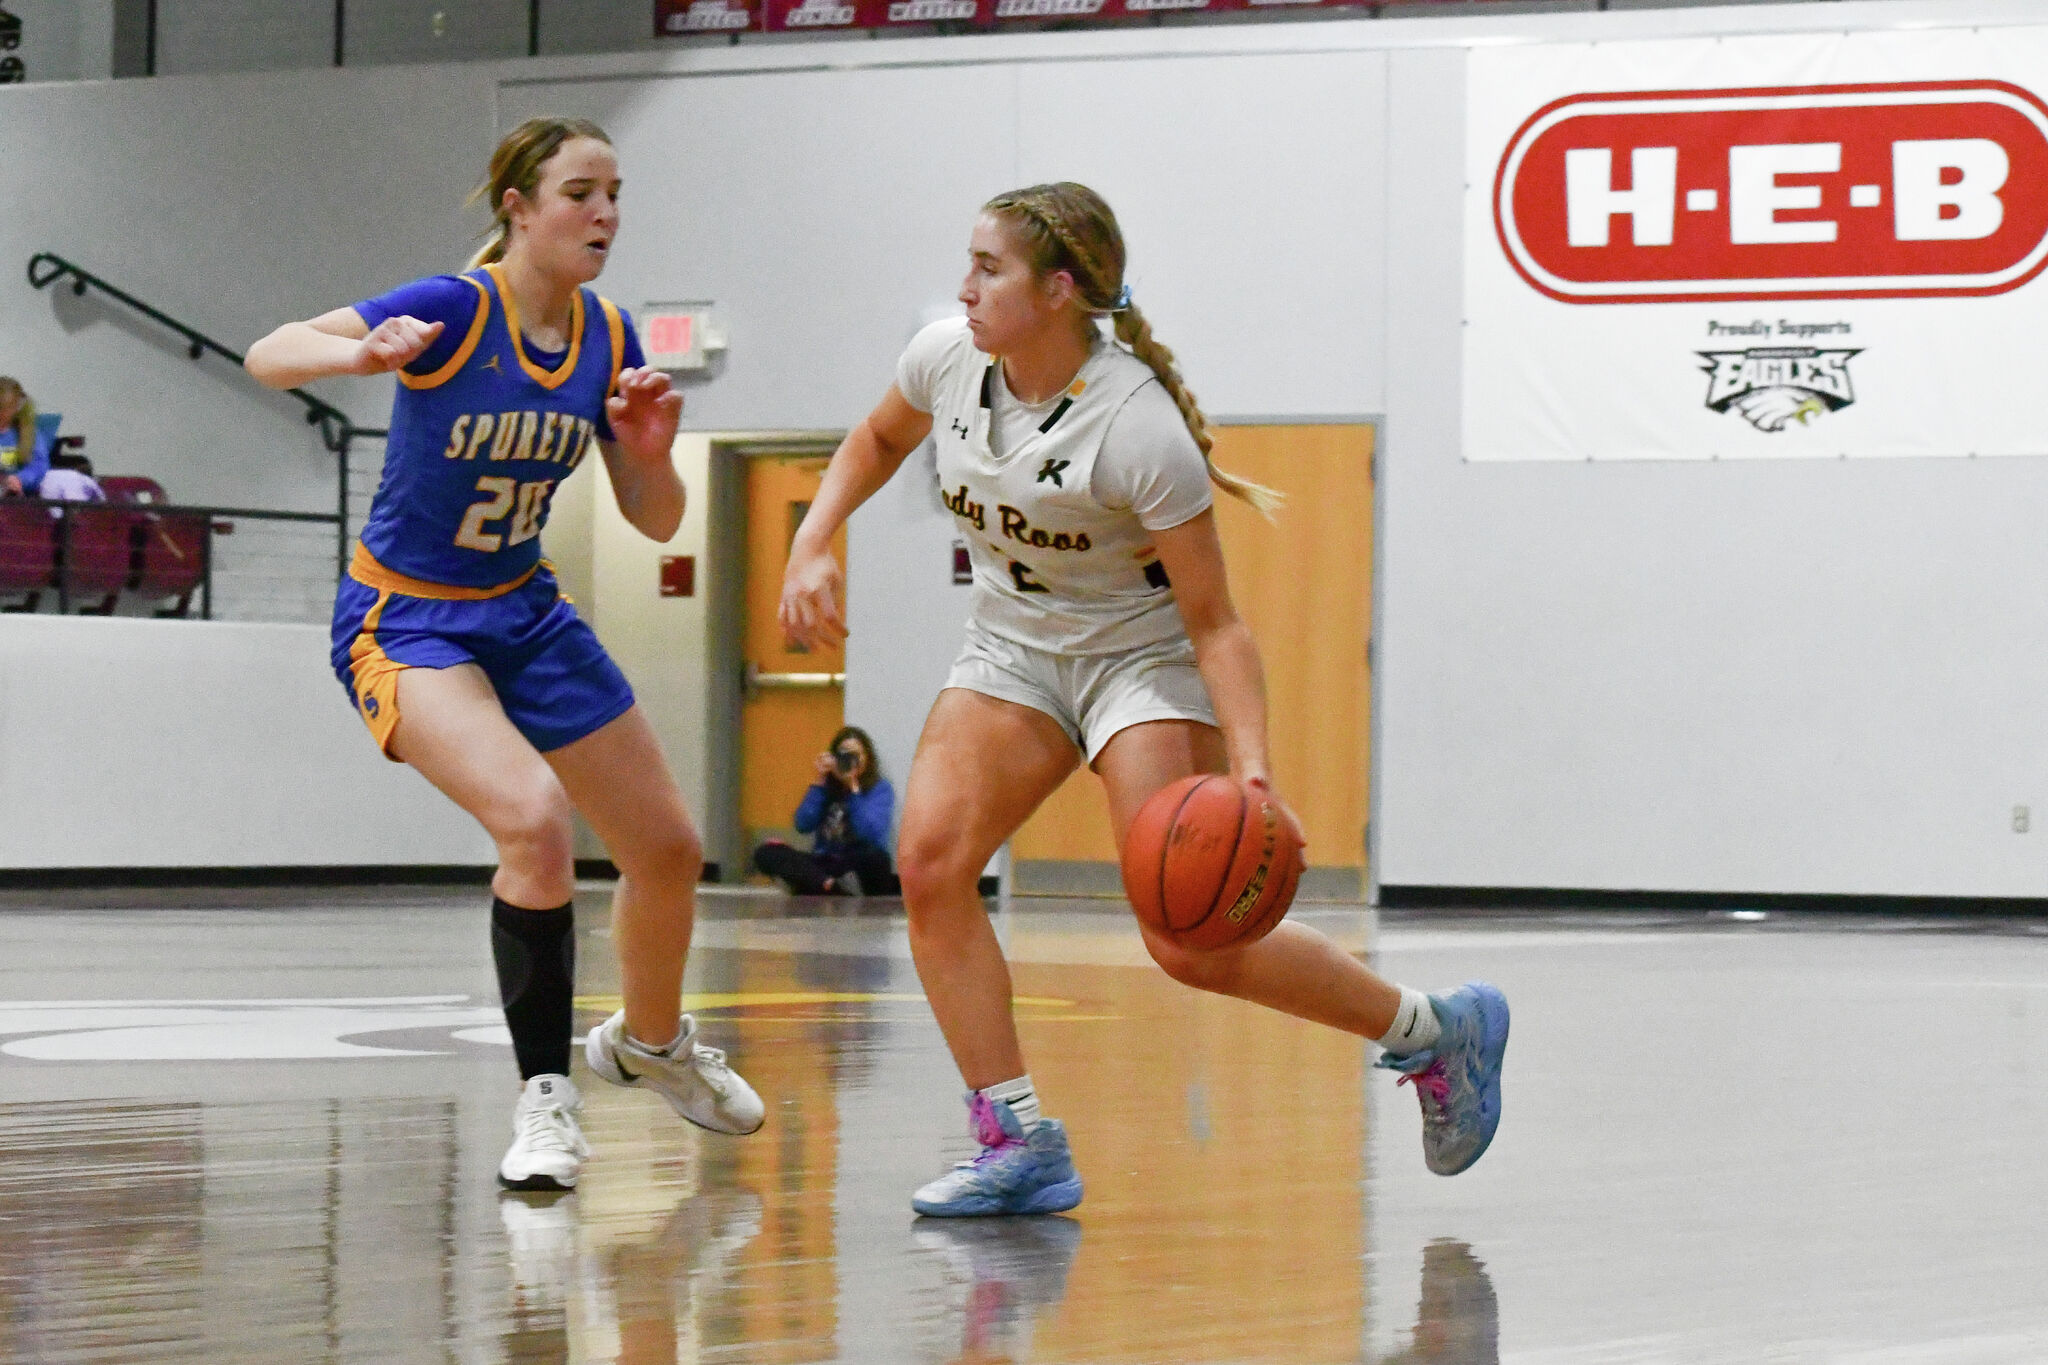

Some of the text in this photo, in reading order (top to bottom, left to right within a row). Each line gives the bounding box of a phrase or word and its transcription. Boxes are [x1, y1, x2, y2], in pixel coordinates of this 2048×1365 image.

[1566, 138, 2010, 247] H-E-B
[1708, 319, 1851, 338] Proudly Supports
[1709, 350, 1854, 401] EAGLES
[443, 411, 596, 467] SPURETT
[453, 475, 554, 552] 20
[998, 504, 1092, 551] Roos
